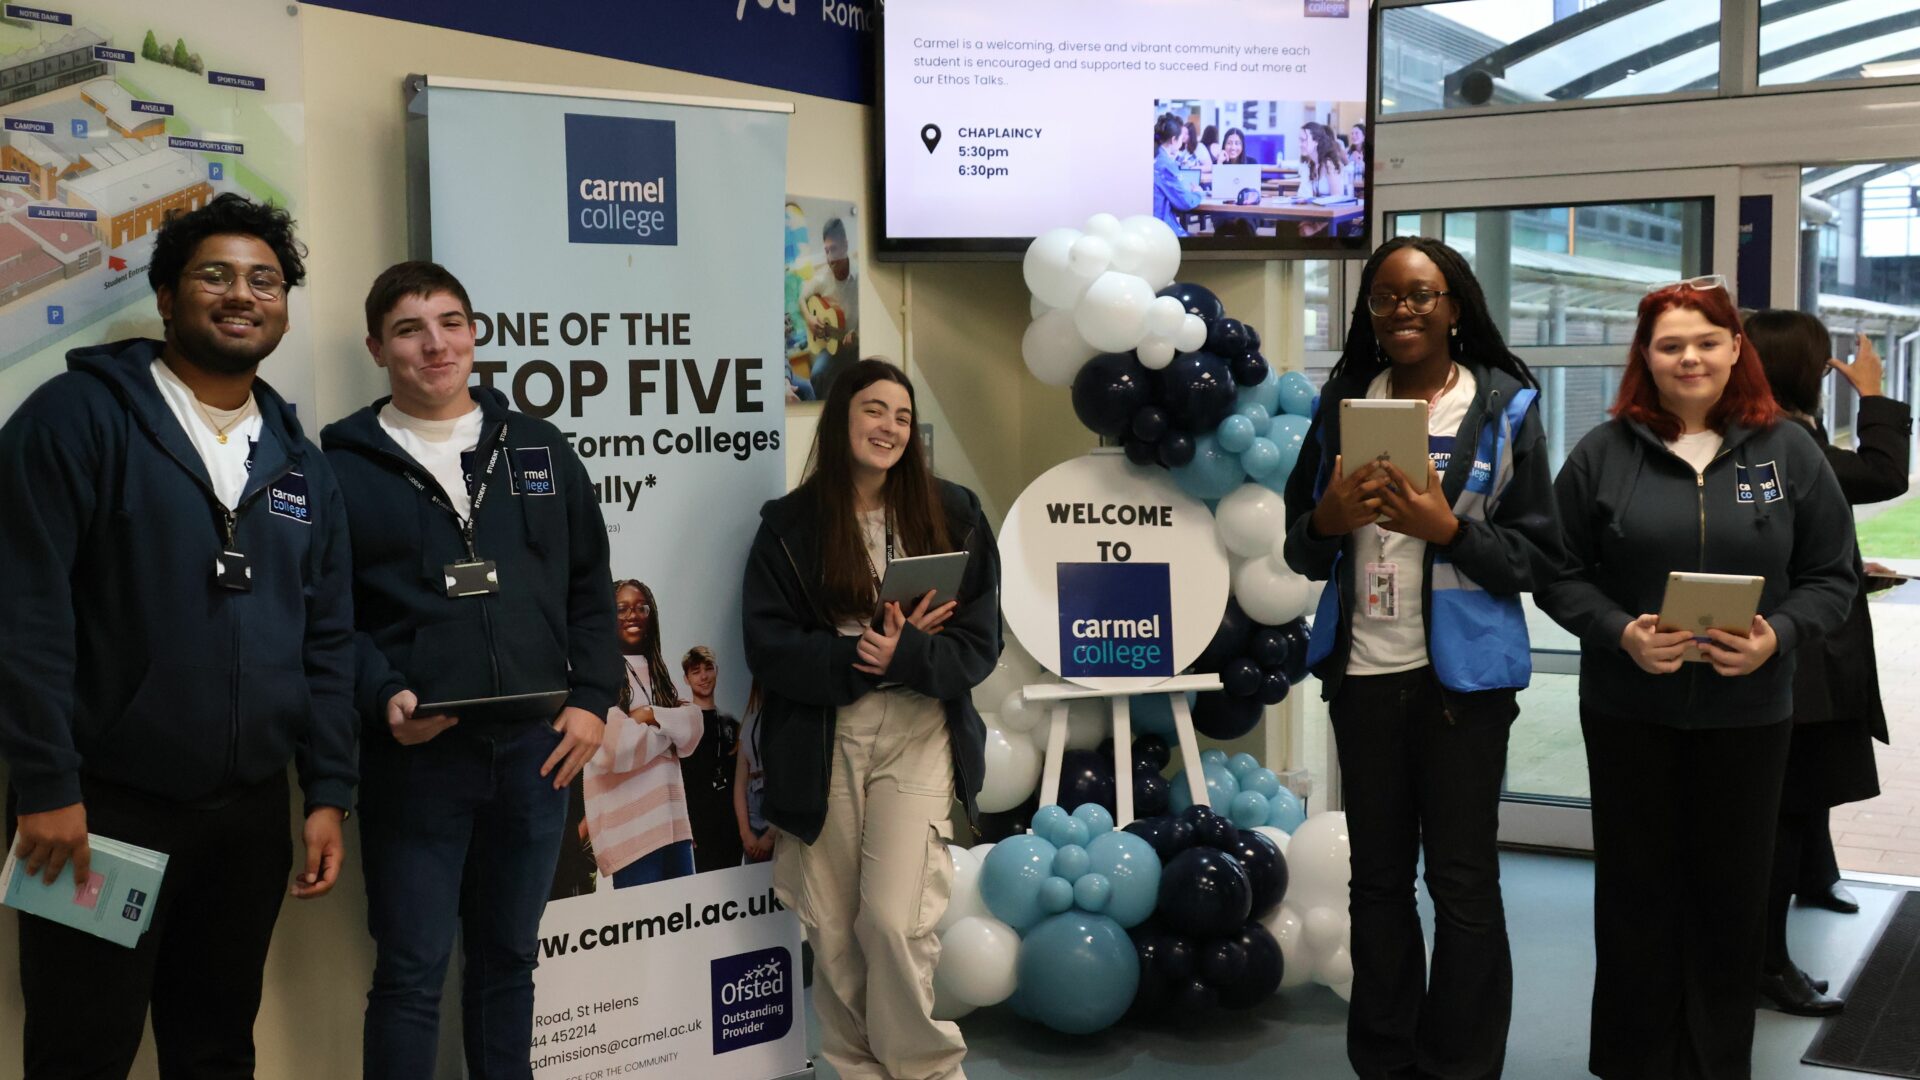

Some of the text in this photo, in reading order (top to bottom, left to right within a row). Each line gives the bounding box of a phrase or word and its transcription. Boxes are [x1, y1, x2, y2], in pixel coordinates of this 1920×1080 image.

[101, 51, 126, 60] STOKER
[914, 38, 1310, 57] Carmel is a welcoming, diverse and vibrant community where each
[914, 56, 960, 67] student
[964, 57, 973, 68] is
[976, 58, 1050, 71] encouraged
[1053, 58, 1077, 69] and
[1080, 59, 1141, 72] supported
[1144, 61, 1156, 70] to
[1214, 61, 1238, 72] Find
[1241, 63, 1259, 72] out
[1262, 63, 1292, 73] more
[1295, 63, 1307, 73] at
[914, 75, 934, 84] our
[937, 74, 970, 85] Ethos
[14, 122, 45, 131] CAMPION
[958, 127, 1042, 138] CHAPLAINCY
[199, 141, 221, 149] SPORTS
[959, 146, 1009, 160] 5:30pm
[959, 165, 1009, 179] 6:30pm
[580, 177, 664, 203] carmel
[38, 209, 88, 219] ALBAN LIBRARY
[580, 203, 665, 237] college
[104, 274, 128, 290] Student
[473, 312, 691, 347] ONE OF THE
[471, 358, 764, 419] TOP FIVE
[652, 426, 780, 460] Colleges
[487, 449, 500, 475] STUDENT
[272, 487, 306, 506] carmel
[475, 482, 487, 509] STUDENT
[273, 499, 307, 518] college
[1046, 503, 1173, 527] WELCOME
[1097, 541, 1131, 562] TO
[1072, 614, 1160, 639] carmel
[1073, 640, 1161, 669] college
[721, 970, 784, 1006] Ofsted
[535, 996, 639, 1028] Road, St Helens
[722, 1004, 784, 1026] Outstanding
[551, 1022, 597, 1044] 452214
[723, 1022, 765, 1040] Provider
[530, 1018, 702, 1071] admissions@carmel.ac.uk
[585, 1069, 603, 1080] FOR
[606, 1065, 622, 1077] THE
[624, 1051, 678, 1073] COMMUNITY
